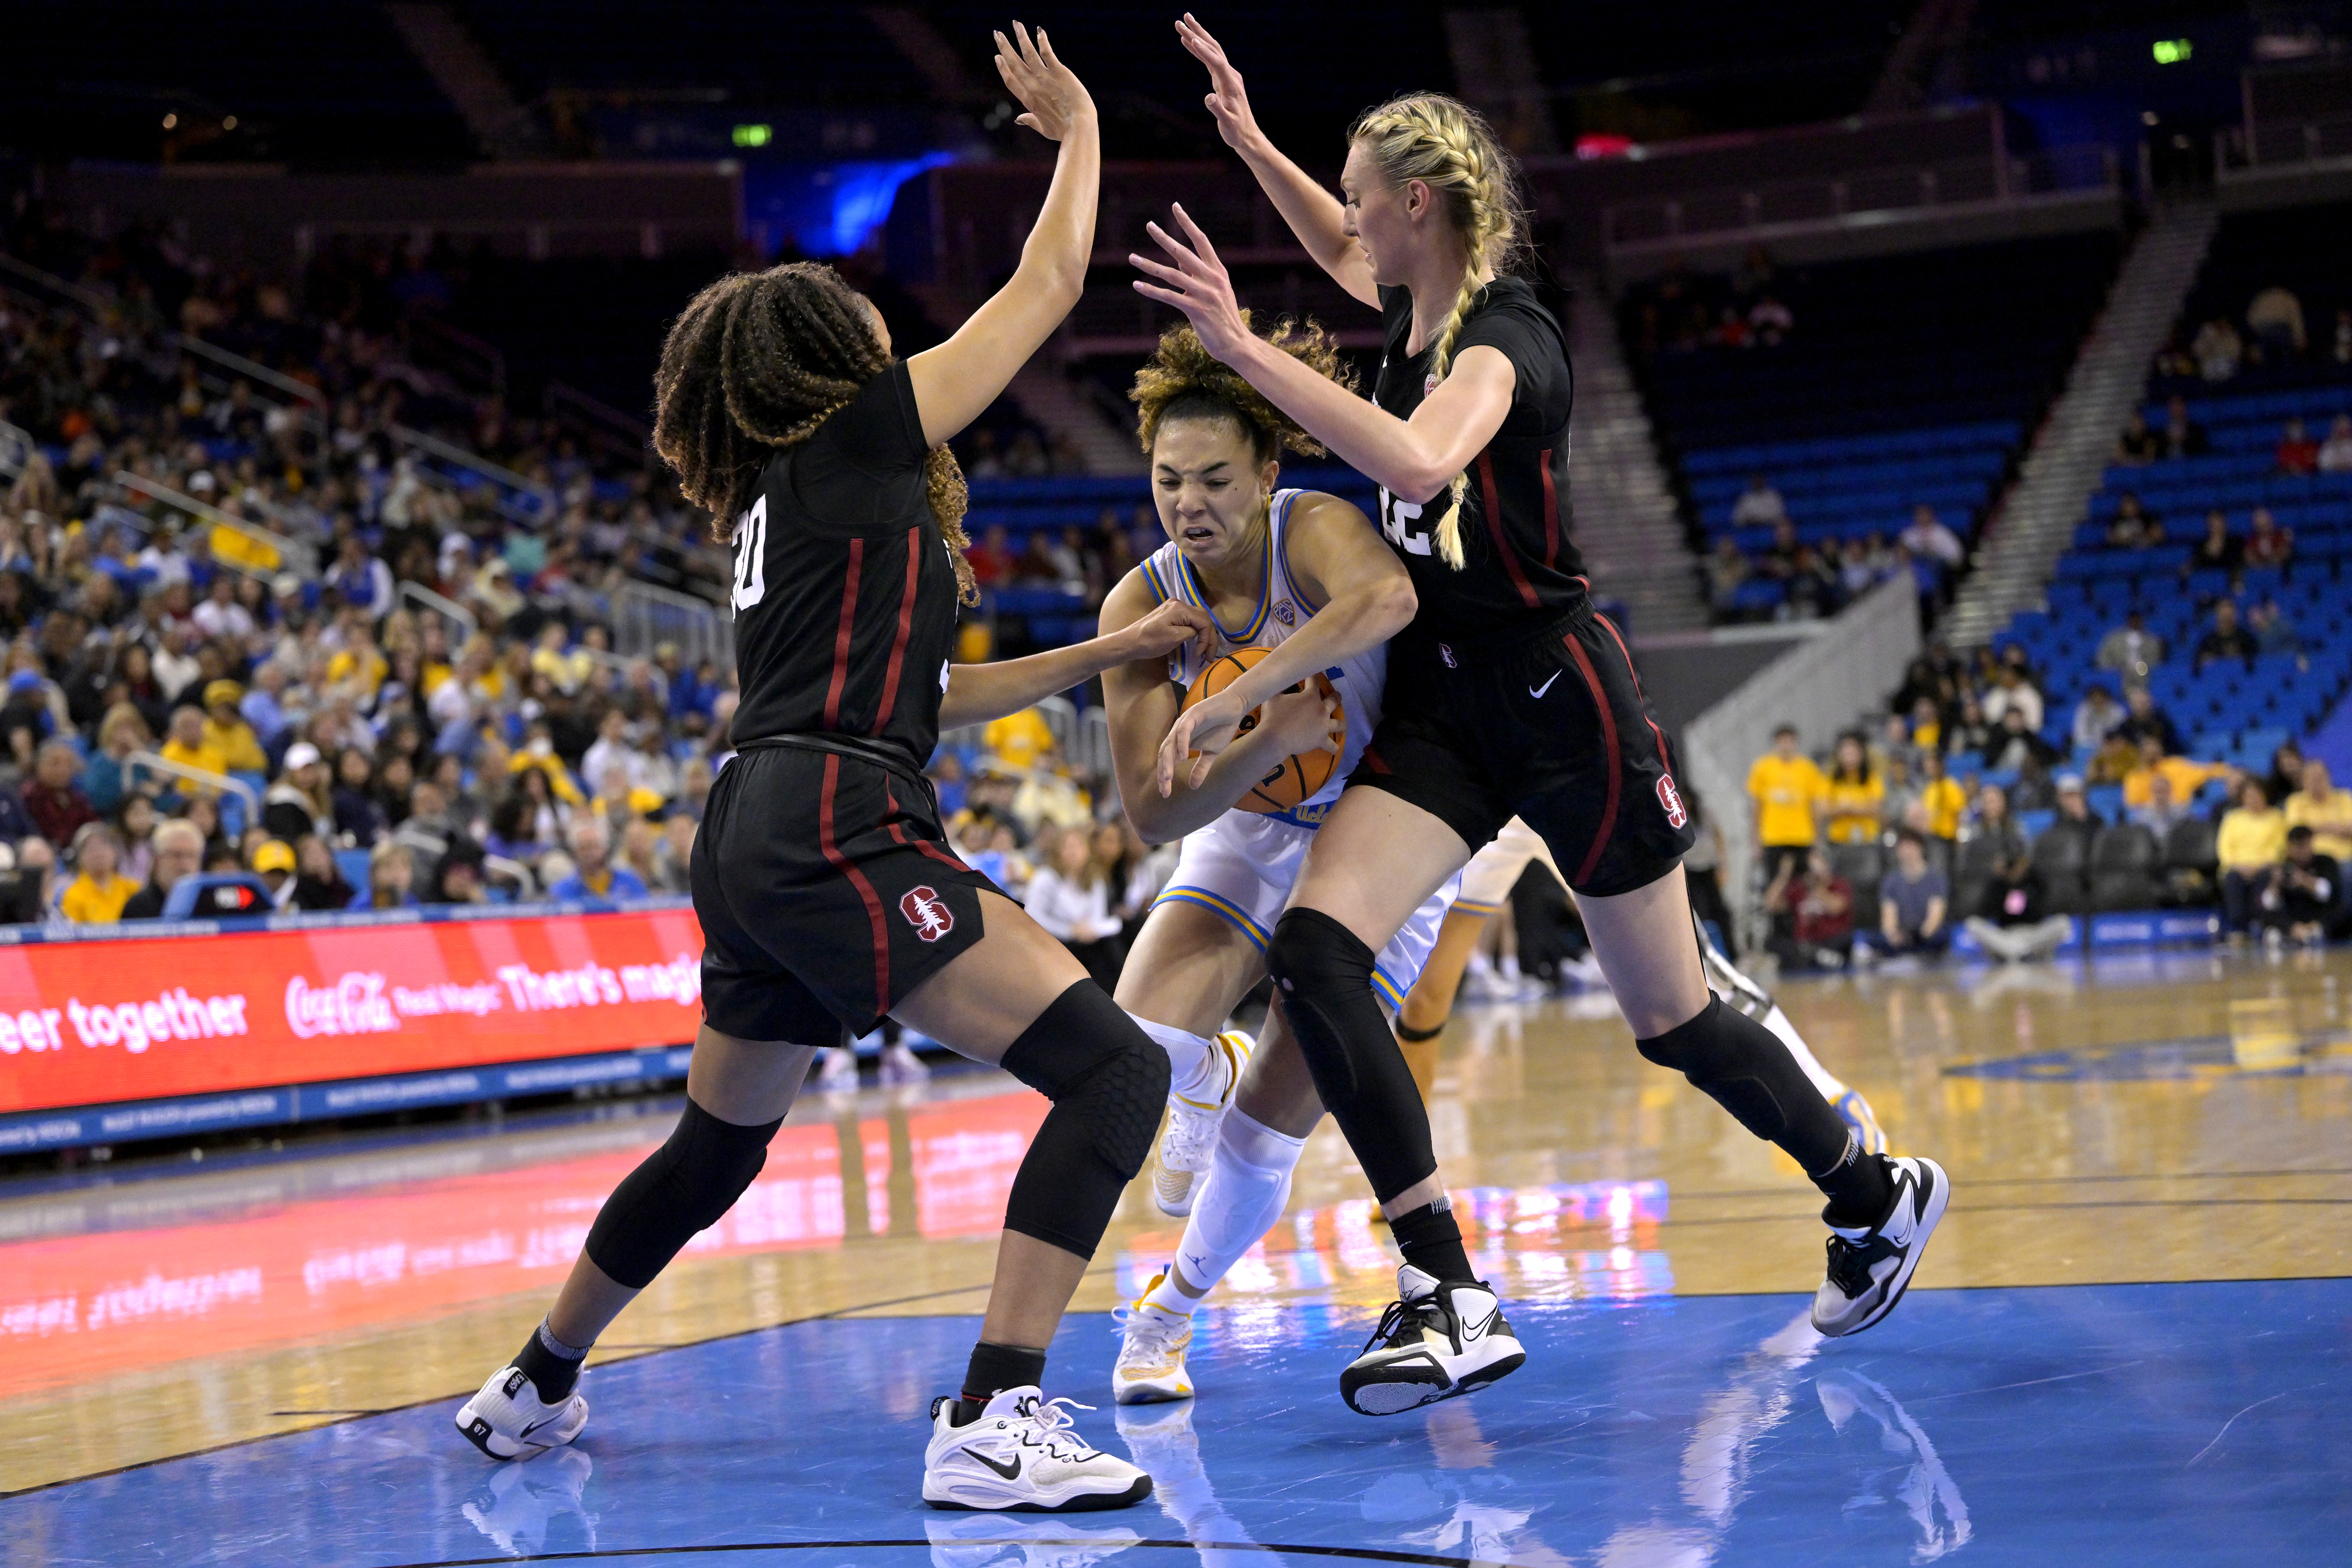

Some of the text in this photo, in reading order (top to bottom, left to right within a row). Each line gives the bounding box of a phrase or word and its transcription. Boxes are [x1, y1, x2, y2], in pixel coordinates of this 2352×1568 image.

[1273, 600, 1294, 621] PAC
[1281, 611, 1293, 624] 12
[67, 986, 247, 1054] together
